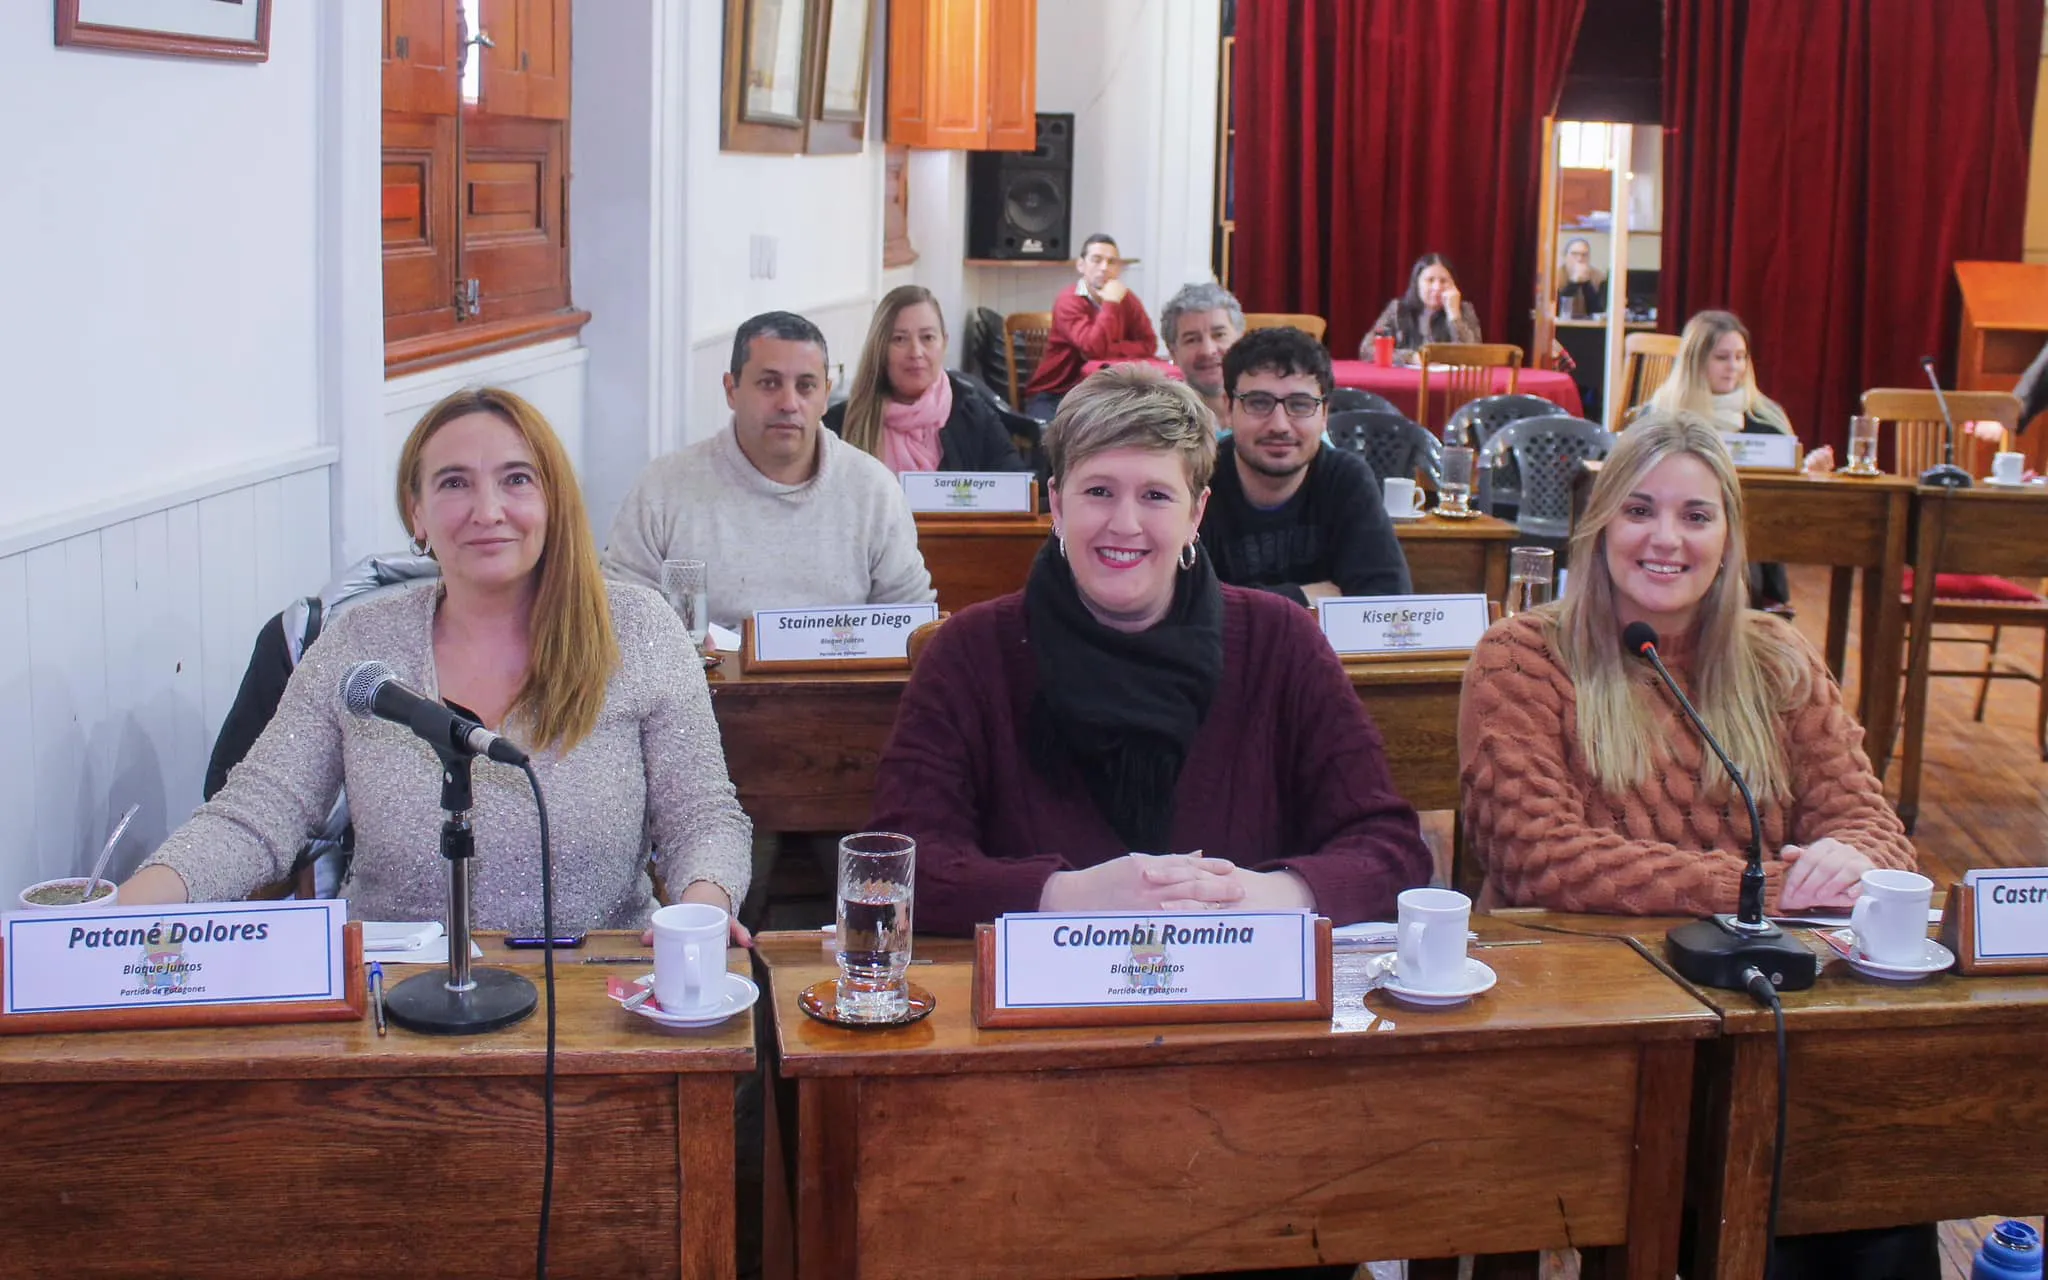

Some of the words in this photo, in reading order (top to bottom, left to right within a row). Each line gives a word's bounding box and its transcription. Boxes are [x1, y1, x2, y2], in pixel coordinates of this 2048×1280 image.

[778, 614, 867, 629] Stainnekker
[871, 613, 911, 629] Diego
[1362, 610, 1398, 624] Kiser
[1401, 608, 1445, 624] Sergio
[1993, 885, 2048, 904] Castr
[68, 922, 162, 949] Patané
[169, 920, 269, 944] Dolores
[1052, 923, 1155, 947] Colombi
[1161, 922, 1254, 945] Romina
[123, 964, 163, 976] Bloque
[164, 961, 202, 974] Juntos
[1110, 964, 1147, 976] Bloque
[1148, 963, 1185, 975] Juntos
[120, 988, 151, 996] Partido
[152, 987, 162, 995] de
[163, 985, 206, 996] Patagones
[1107, 987, 1136, 996] Partido
[1148, 985, 1188, 996] Patagones
